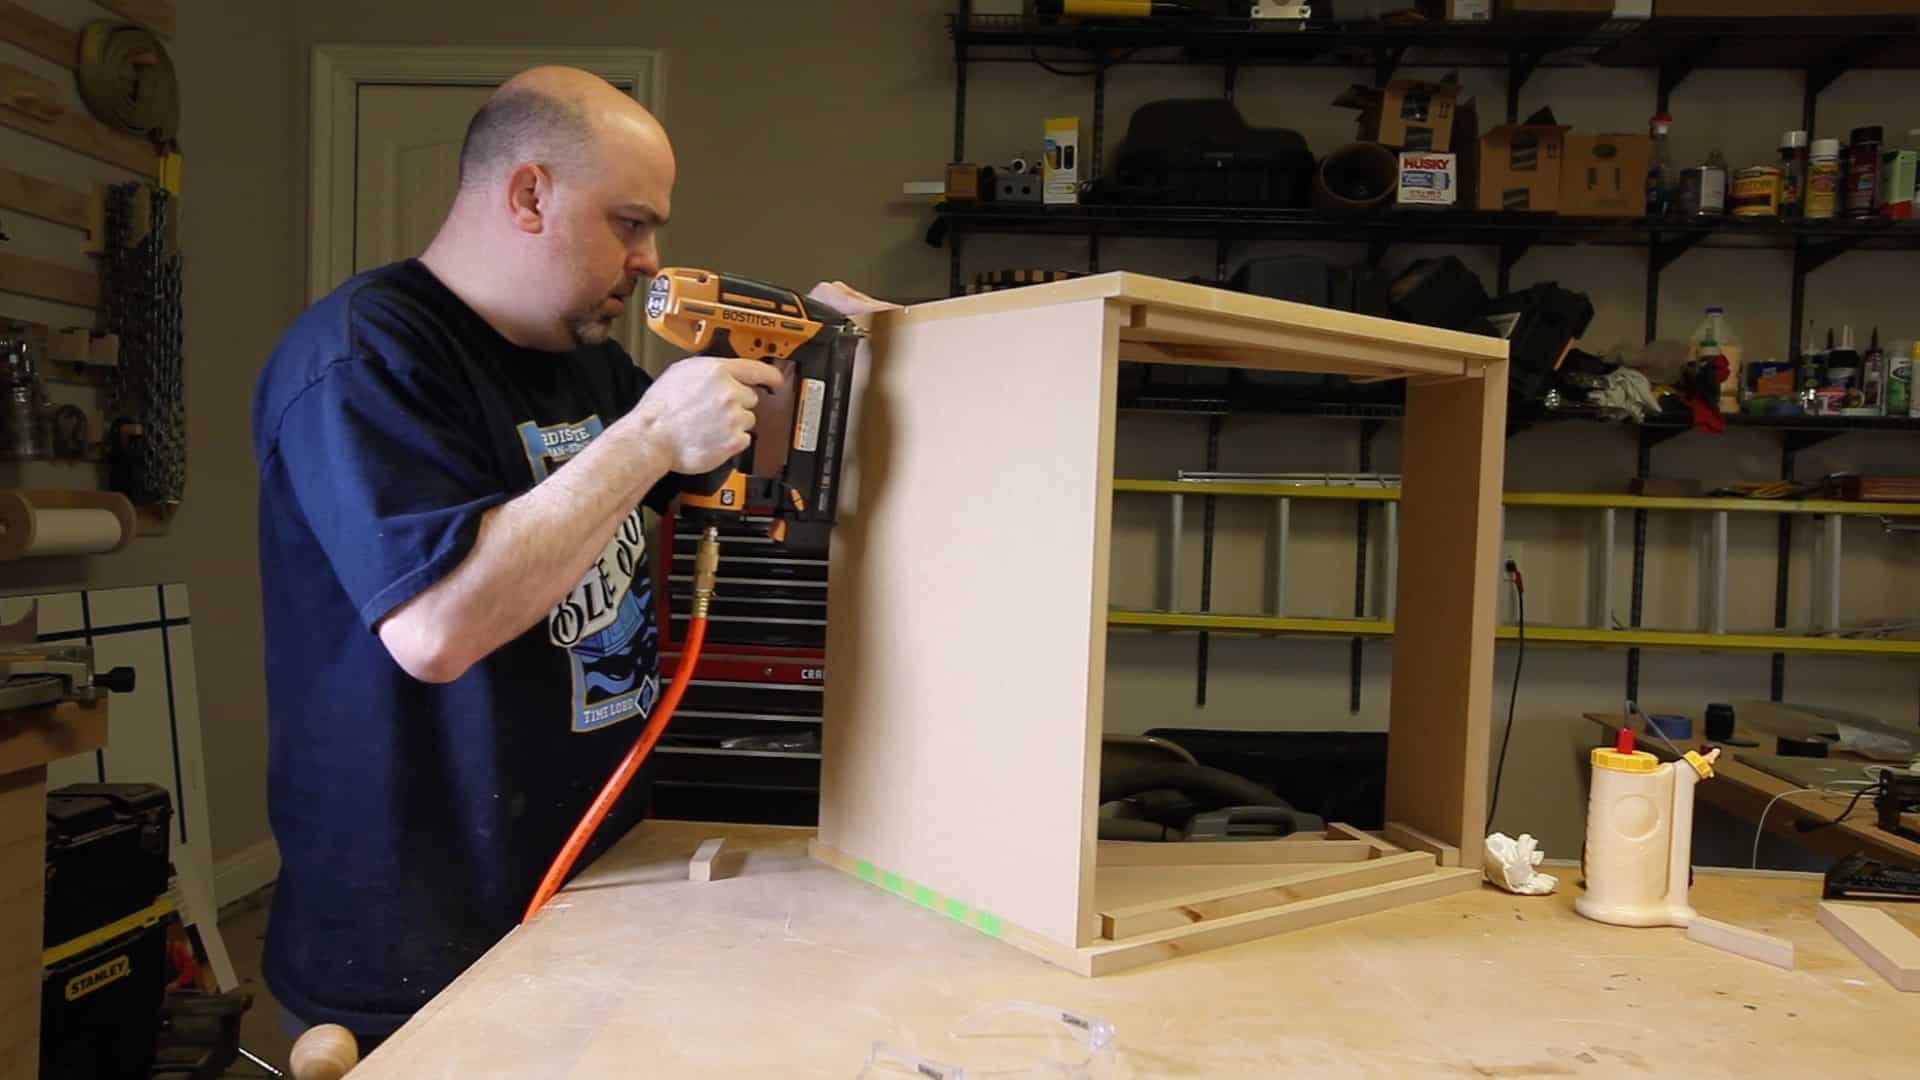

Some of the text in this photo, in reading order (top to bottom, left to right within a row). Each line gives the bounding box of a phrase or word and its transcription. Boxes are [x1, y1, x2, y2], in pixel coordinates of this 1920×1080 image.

[1403, 158, 1450, 169] HUSKY
[722, 309, 776, 328] BOSTITCH
[800, 668, 825, 680] CRA
[70, 960, 126, 994] STANLEY
